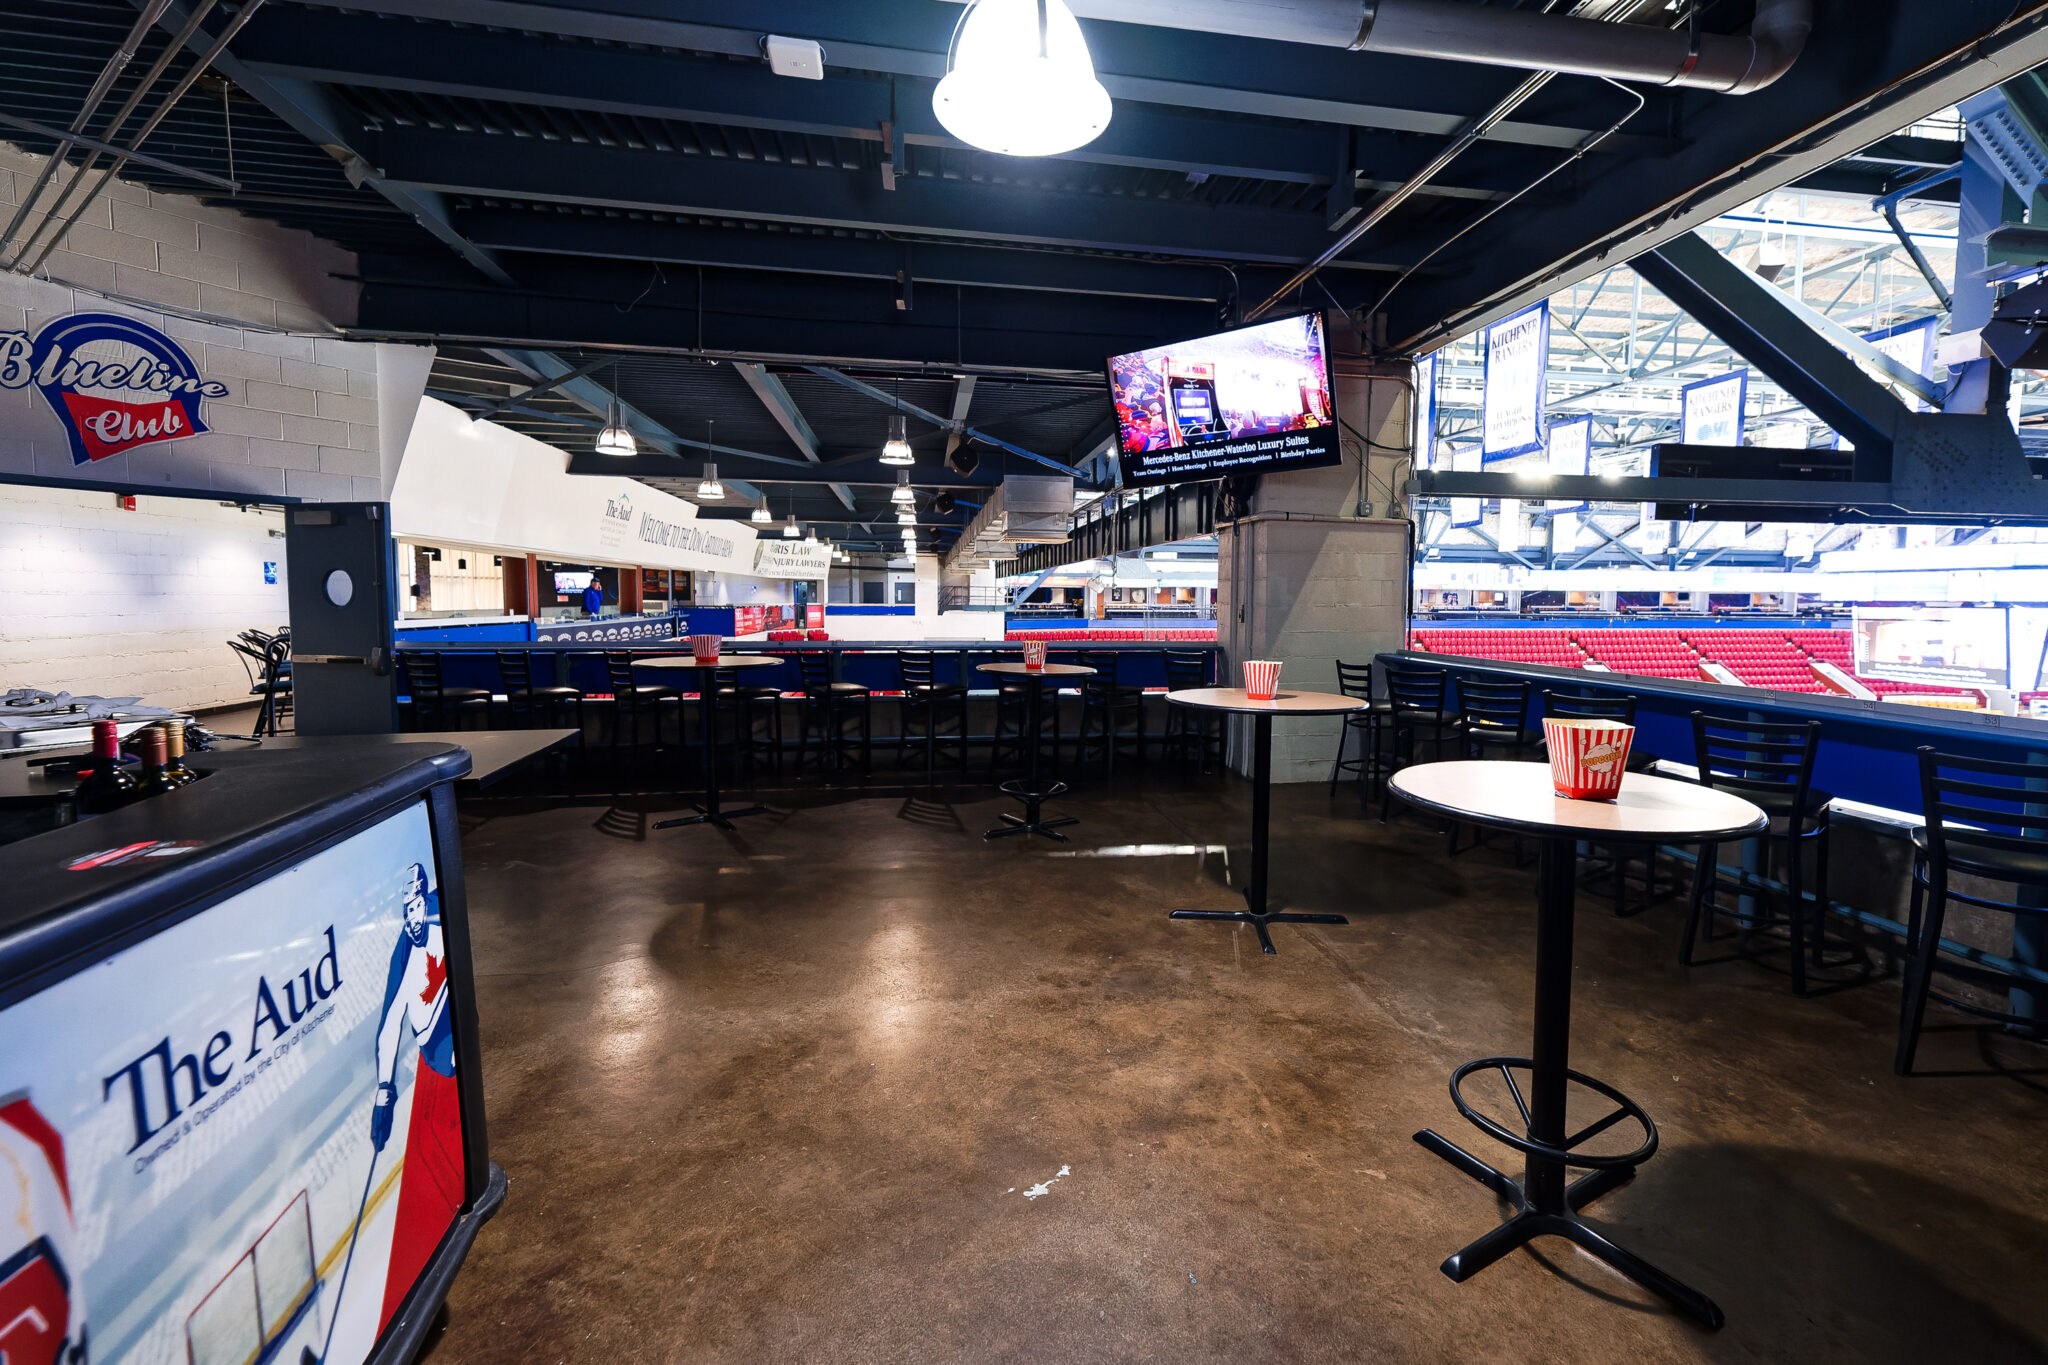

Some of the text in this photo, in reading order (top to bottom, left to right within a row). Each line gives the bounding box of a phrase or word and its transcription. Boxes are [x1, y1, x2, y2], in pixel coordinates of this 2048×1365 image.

[1491, 318, 1538, 350] KITCHENER
[0, 330, 229, 398] Blueline
[1495, 340, 1533, 363] RANGERS
[1693, 401, 1732, 418] RANGERS
[85, 406, 184, 444] Club
[1143, 436, 1310, 466] Mercedes-Benz Kitchener-Waterloo Luxury Suites
[1213, 458, 1239, 467] Employee
[1280, 449, 1305, 458] Birthday
[605, 499, 634, 521] The Aud
[639, 511, 672, 546] WELCOME
[791, 542, 812, 556] LAW
[795, 559, 826, 568] LAWYERS
[1581, 750, 1621, 767] POPCORN
[104, 924, 343, 1156] The Aud
[193, 1080, 242, 1126] Operated
[243, 1071, 256, 1086] by
[257, 1059, 273, 1074] the
[274, 1042, 290, 1060] City
[291, 1031, 301, 1046] of
[301, 1004, 336, 1039] Kitchener
